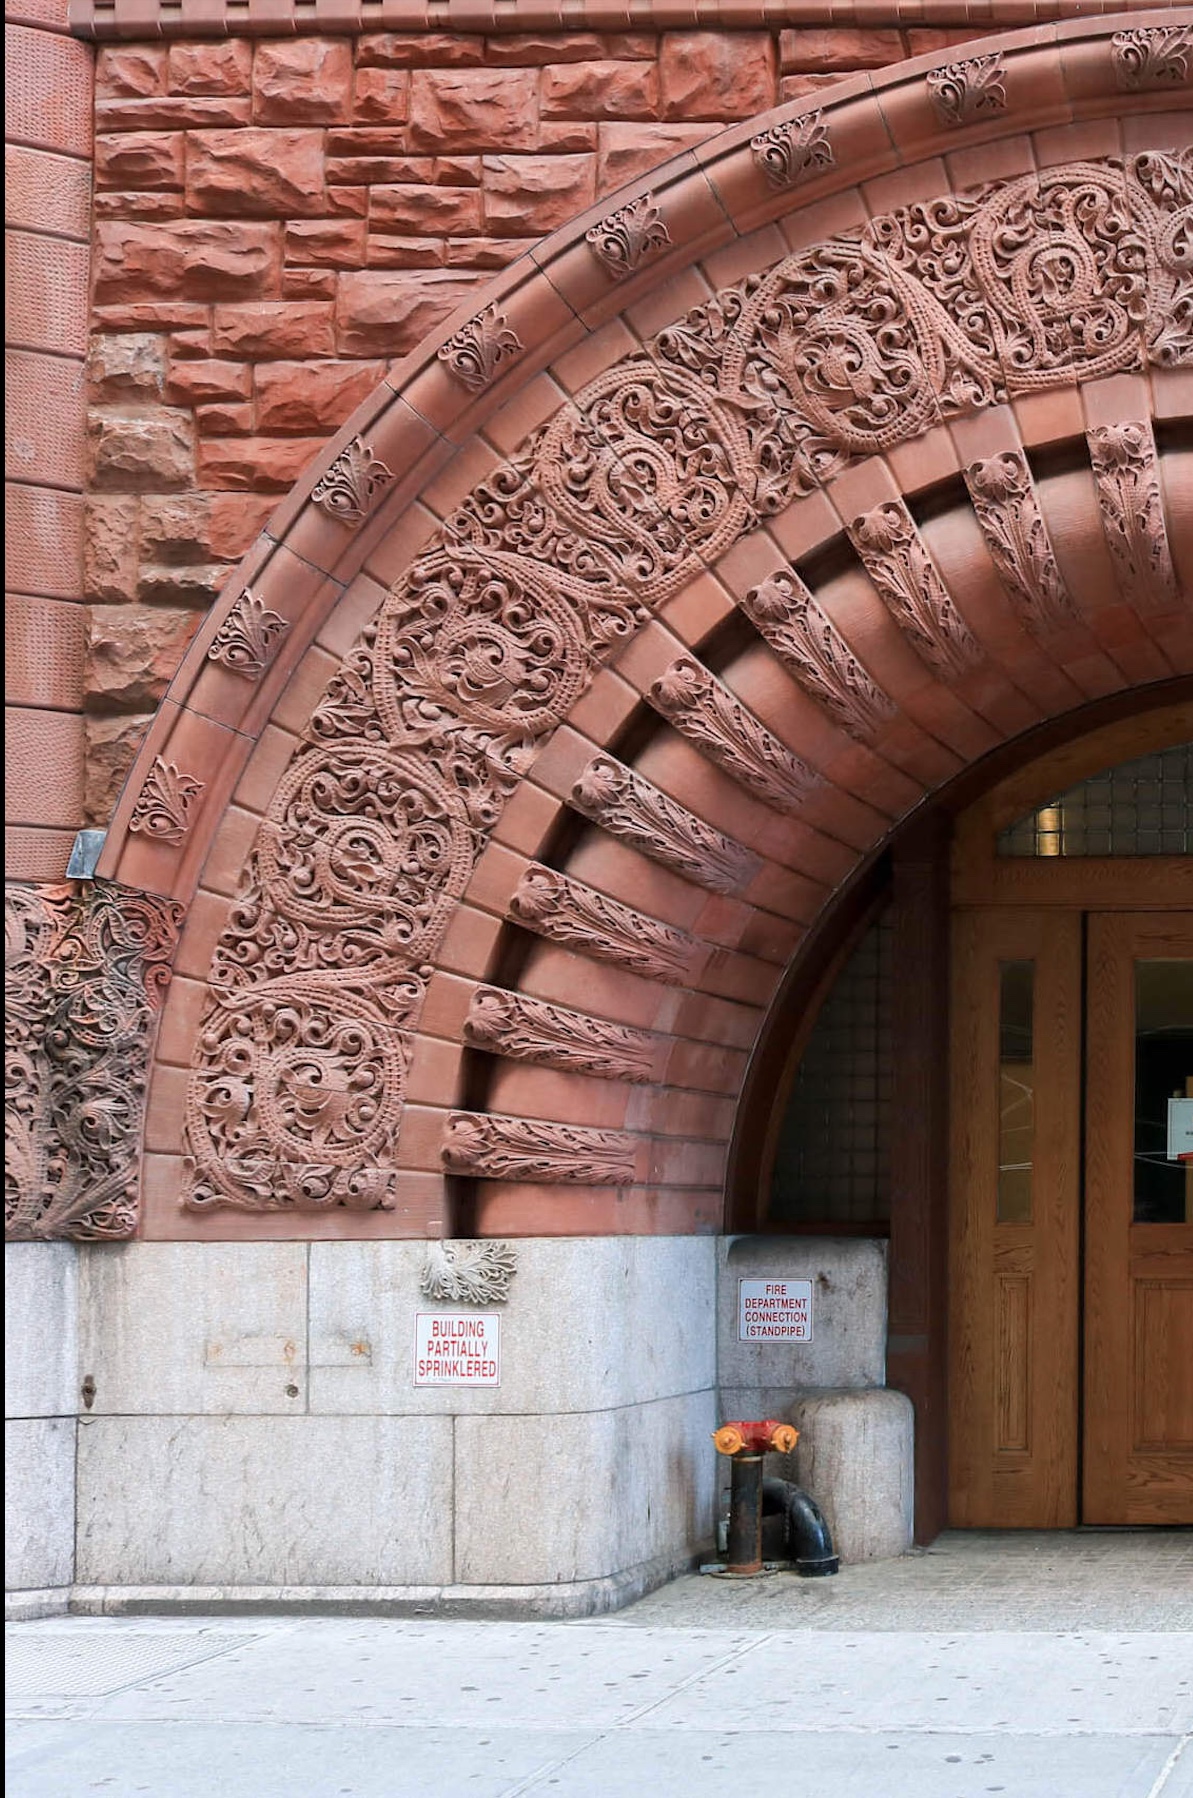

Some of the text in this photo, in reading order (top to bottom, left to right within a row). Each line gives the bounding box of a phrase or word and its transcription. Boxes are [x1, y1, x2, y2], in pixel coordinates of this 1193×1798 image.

[765, 1284, 788, 1295] FIRE
[744, 1298, 808, 1309] DEPARTMENT
[744, 1311, 808, 1323] CONNECTION
[432, 1320, 485, 1337] BUILDING
[746, 1325, 806, 1338] (STANDPIPE)
[427, 1340, 489, 1357] PARTIALLY
[418, 1359, 497, 1377] SPRINKLERED
